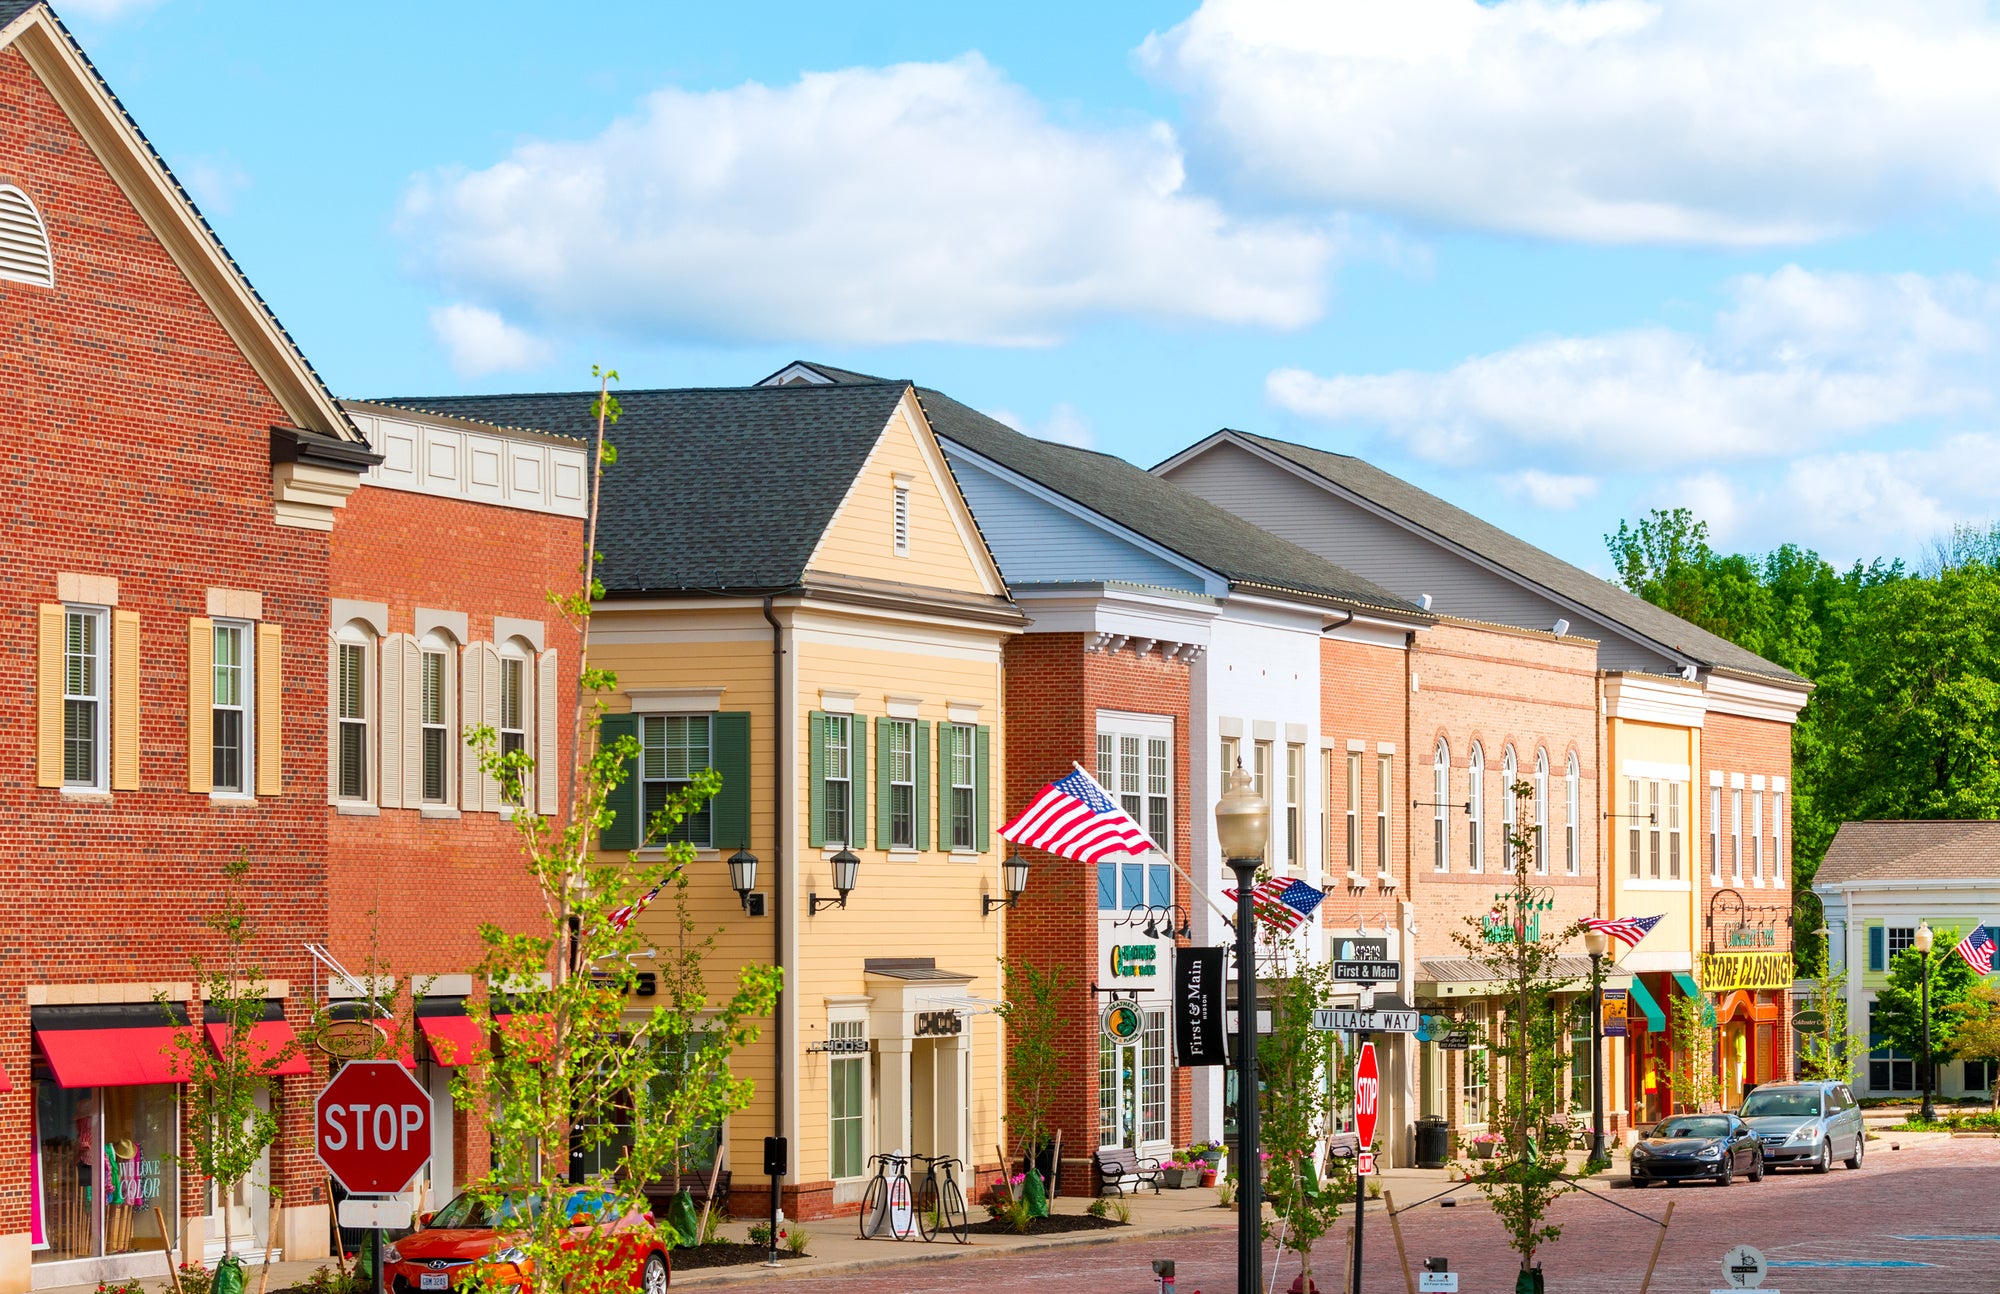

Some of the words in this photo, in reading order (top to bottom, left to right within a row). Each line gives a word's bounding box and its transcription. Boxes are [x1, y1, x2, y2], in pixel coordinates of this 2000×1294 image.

[1188, 960, 1202, 1000] Main
[1337, 965, 1360, 977] First
[1361, 965, 1370, 978] &
[1372, 965, 1396, 978] Main
[1704, 955, 1739, 988] STORE
[1739, 955, 1791, 986] CLOSING!
[1189, 1003, 1200, 1016] &
[1321, 1012, 1375, 1028] VILLAGE
[1383, 1013, 1410, 1029] WAY
[1189, 1020, 1204, 1055] First
[1357, 1077, 1377, 1115] STOP
[324, 1103, 424, 1151] STOP
[120, 1162, 134, 1177] WE
[136, 1160, 160, 1176] LOVE
[120, 1177, 160, 1199] COLOR
